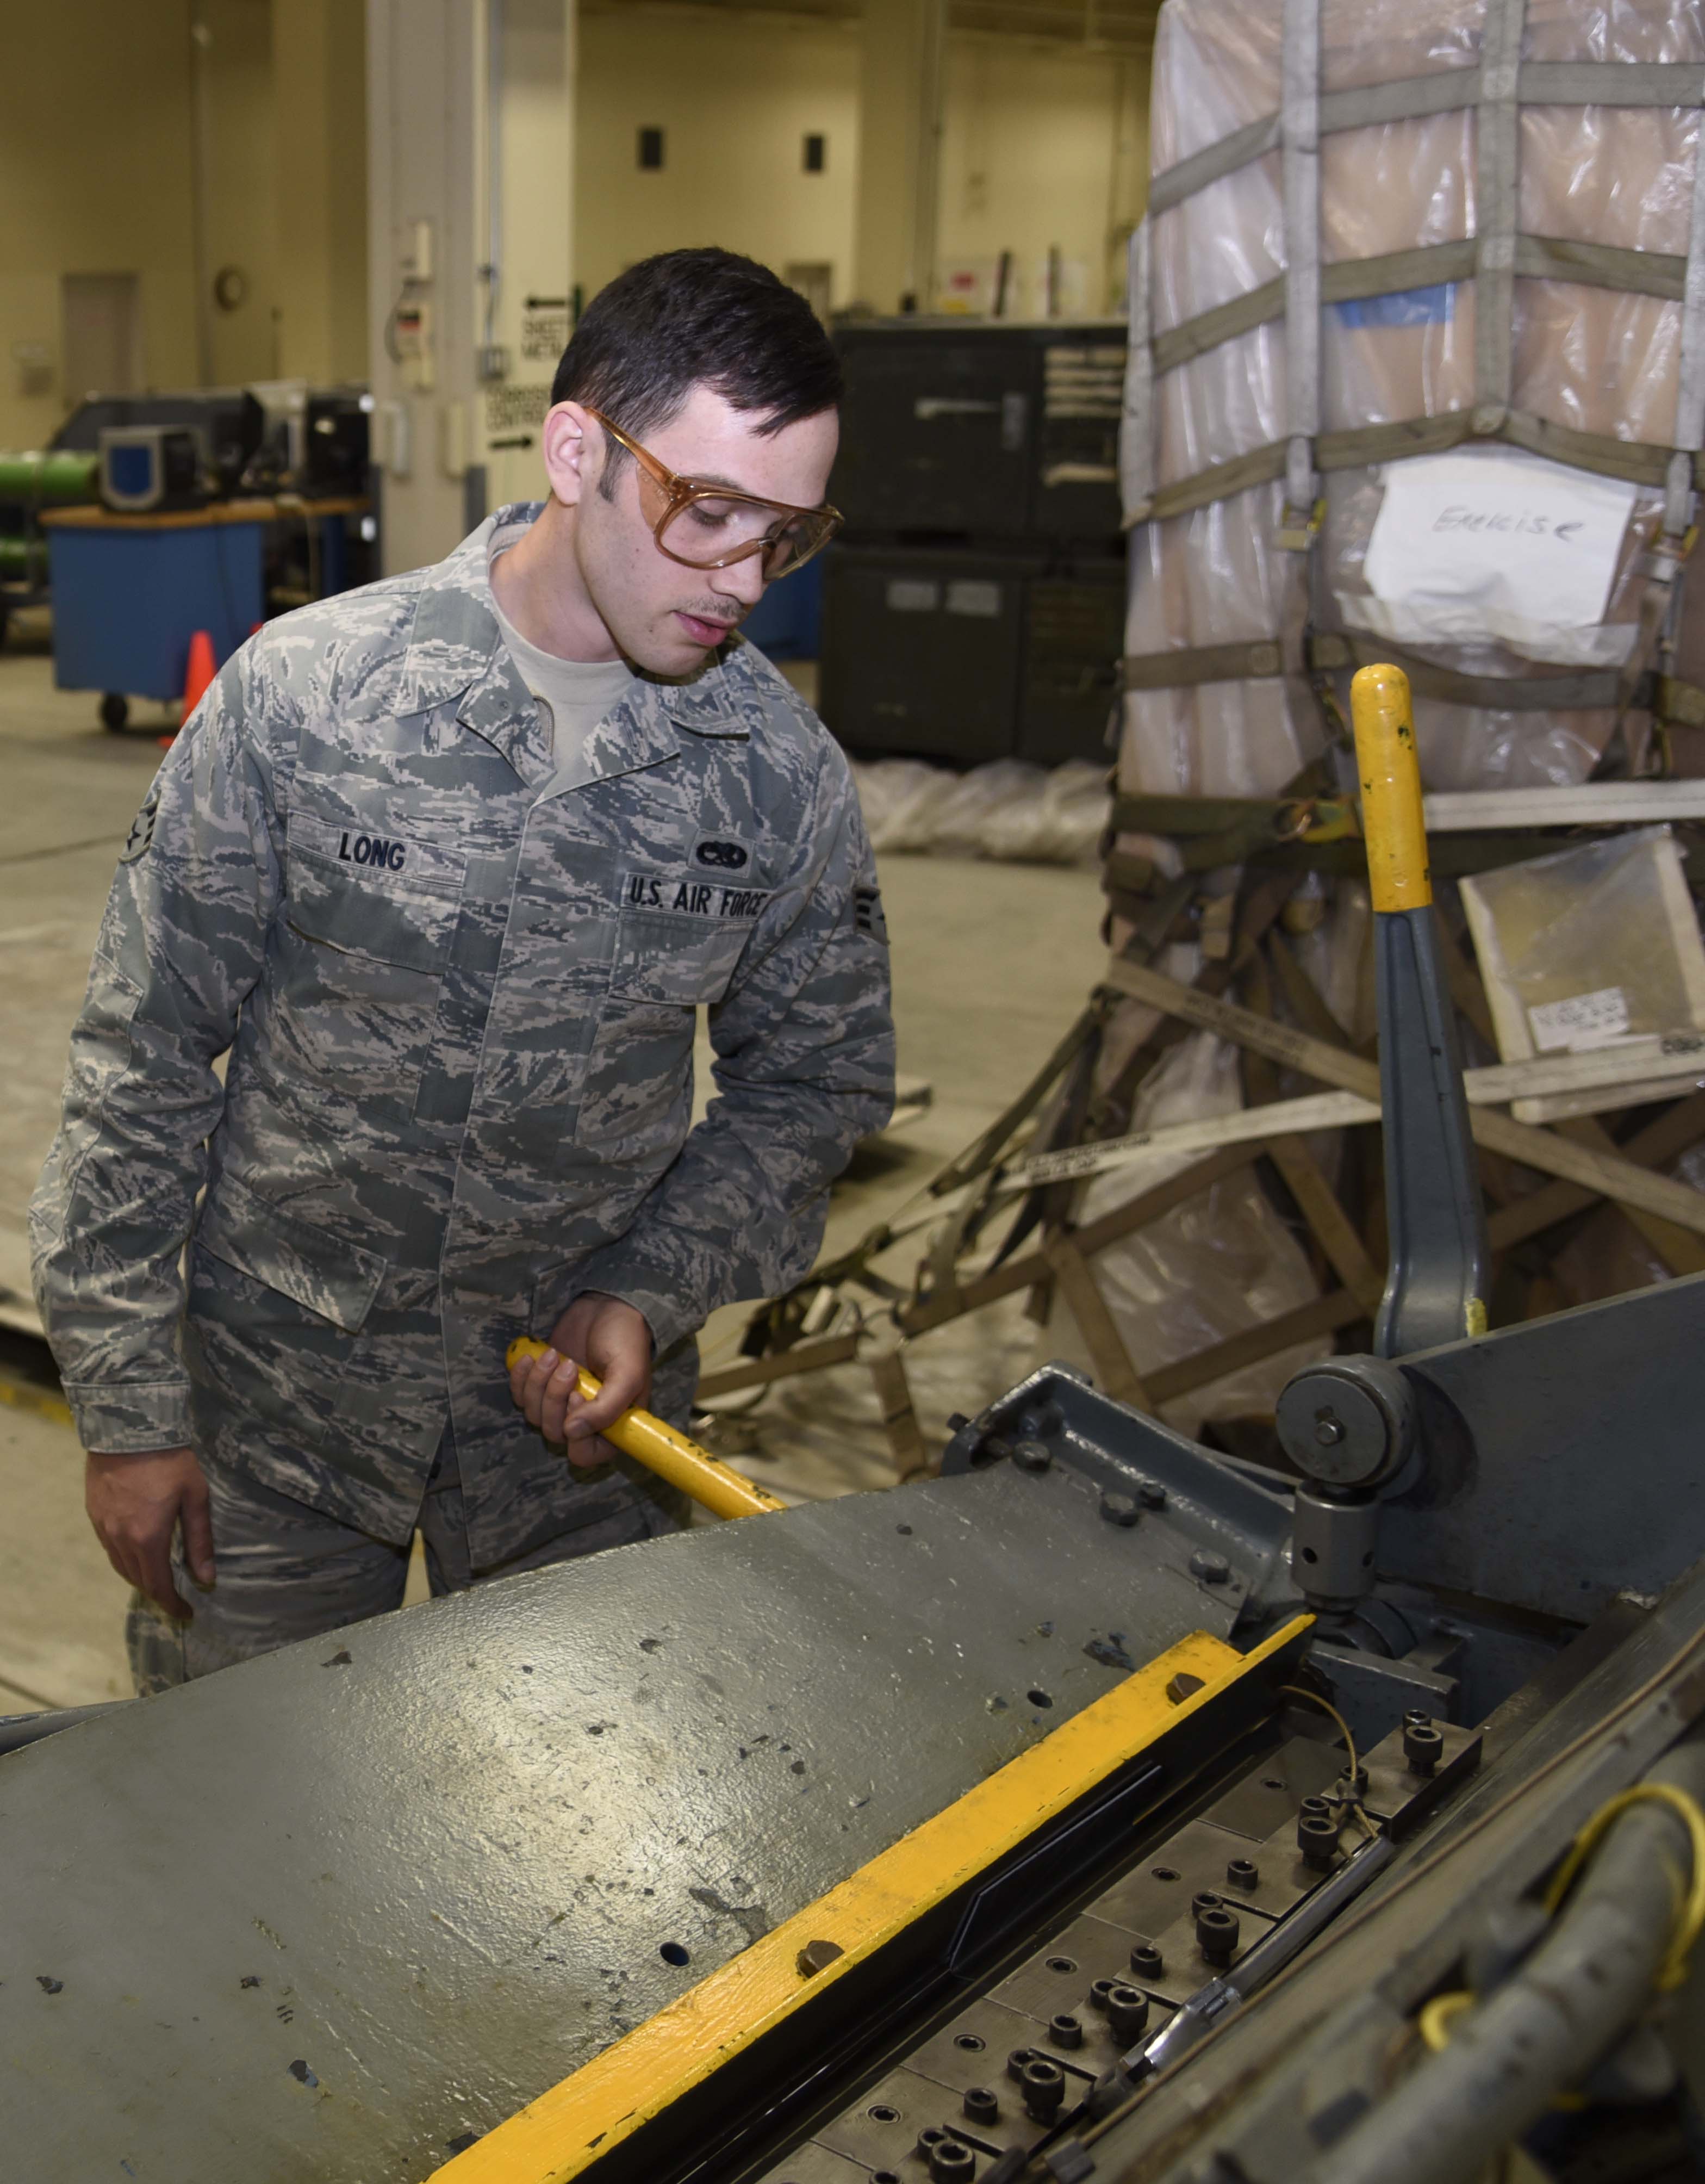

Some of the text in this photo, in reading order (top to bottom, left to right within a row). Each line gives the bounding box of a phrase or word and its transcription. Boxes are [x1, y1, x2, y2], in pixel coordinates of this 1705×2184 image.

[339, 832, 406, 871] LONG
[629, 876, 768, 917] U.S. AIR FORCE
